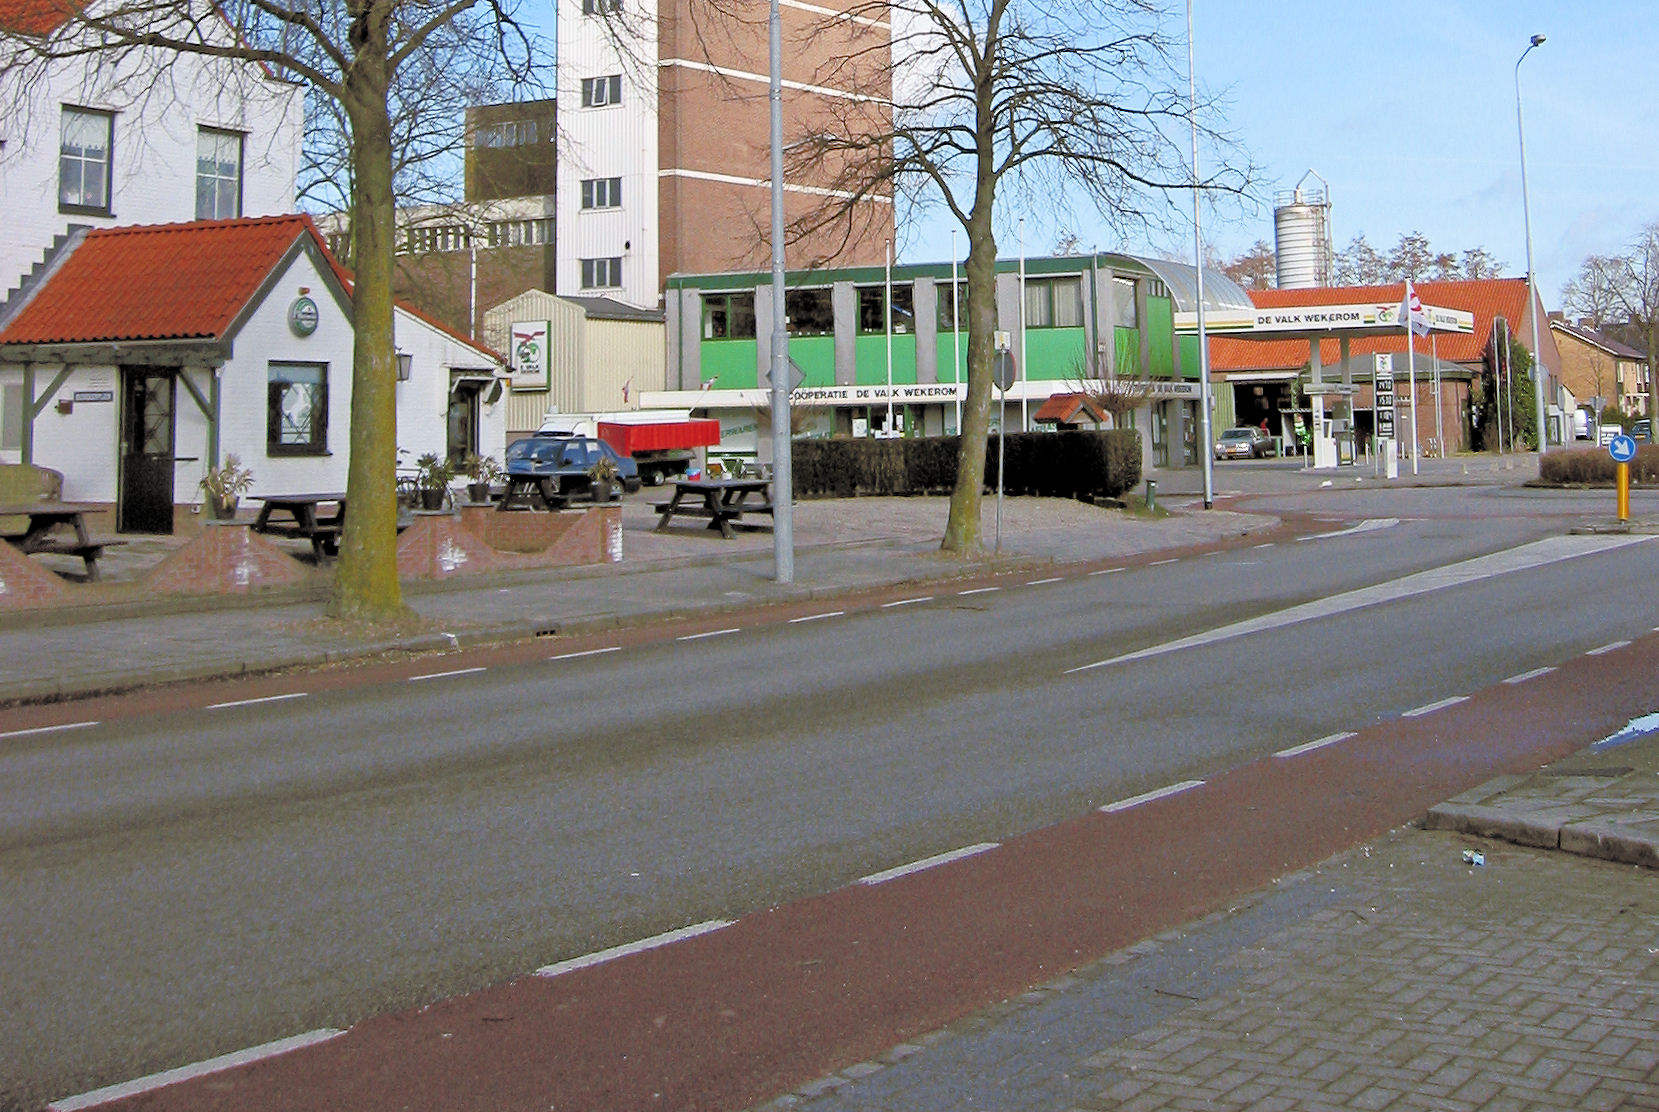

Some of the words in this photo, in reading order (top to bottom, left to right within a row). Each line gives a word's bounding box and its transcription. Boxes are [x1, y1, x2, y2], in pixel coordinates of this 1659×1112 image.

[1258, 316, 1272, 324] DE
[1275, 314, 1301, 323] VALK
[1304, 312, 1360, 322] WEKEROM
[856, 389, 869, 398] DE
[874, 388, 900, 398] VAK
[903, 387, 957, 397] WEKEROM
